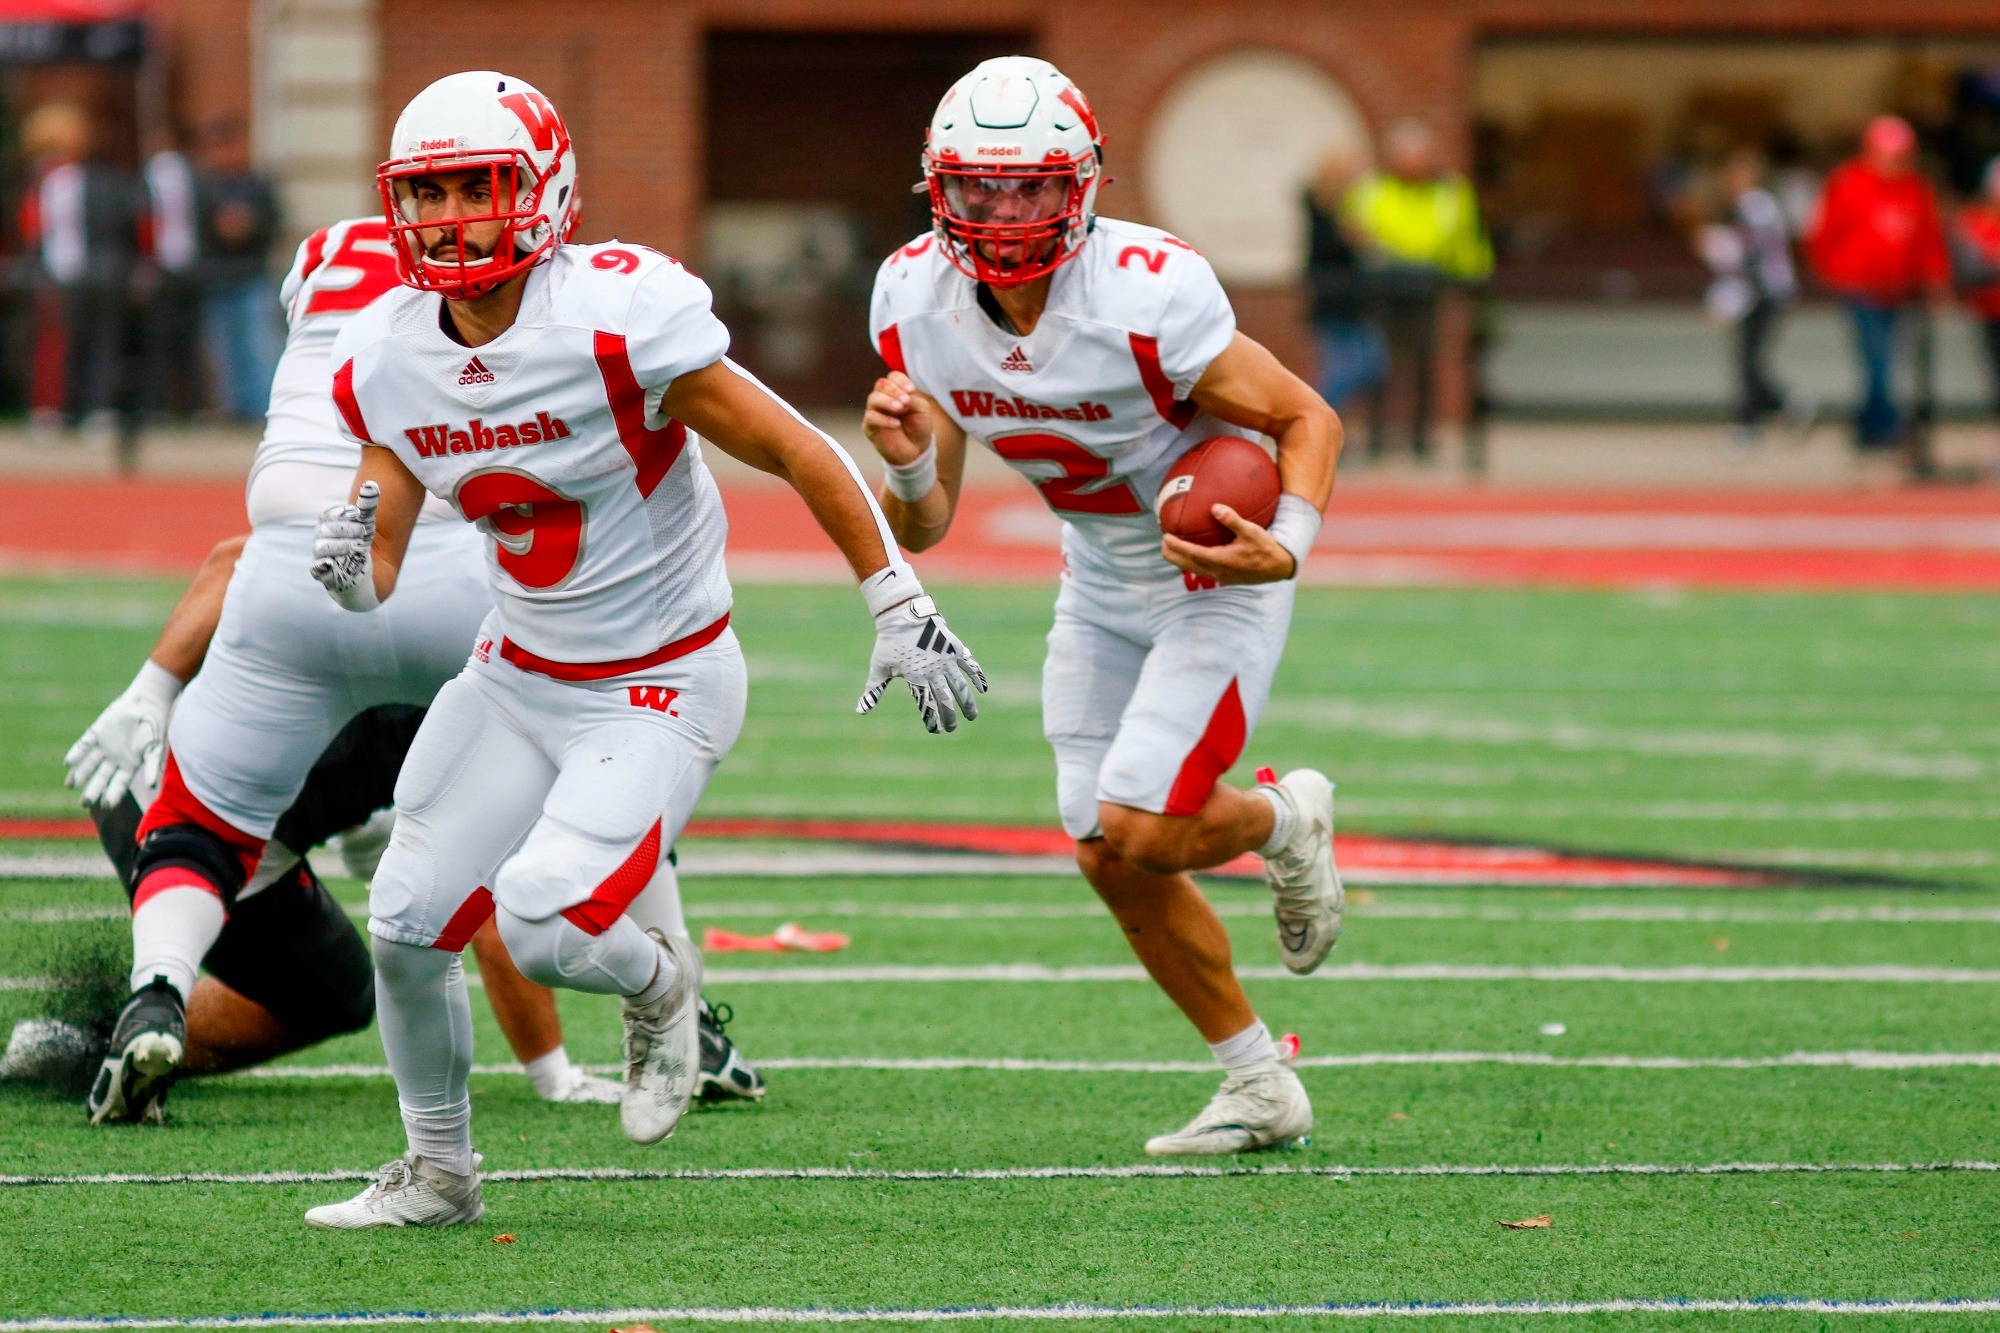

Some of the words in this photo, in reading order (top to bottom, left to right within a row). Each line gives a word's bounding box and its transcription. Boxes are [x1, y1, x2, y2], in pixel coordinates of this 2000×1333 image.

[498, 92, 572, 152] W
[420, 137, 455, 151] Riddell
[977, 146, 1022, 156] Riddell
[589, 248, 642, 276] 9
[1116, 244, 1170, 275] 2
[458, 371, 495, 386] adidas
[1000, 360, 1033, 372] adidas
[949, 389, 1112, 423] Wabash
[403, 410, 571, 459] Wabash
[986, 427, 1149, 516] 2
[453, 465, 589, 592] 9
